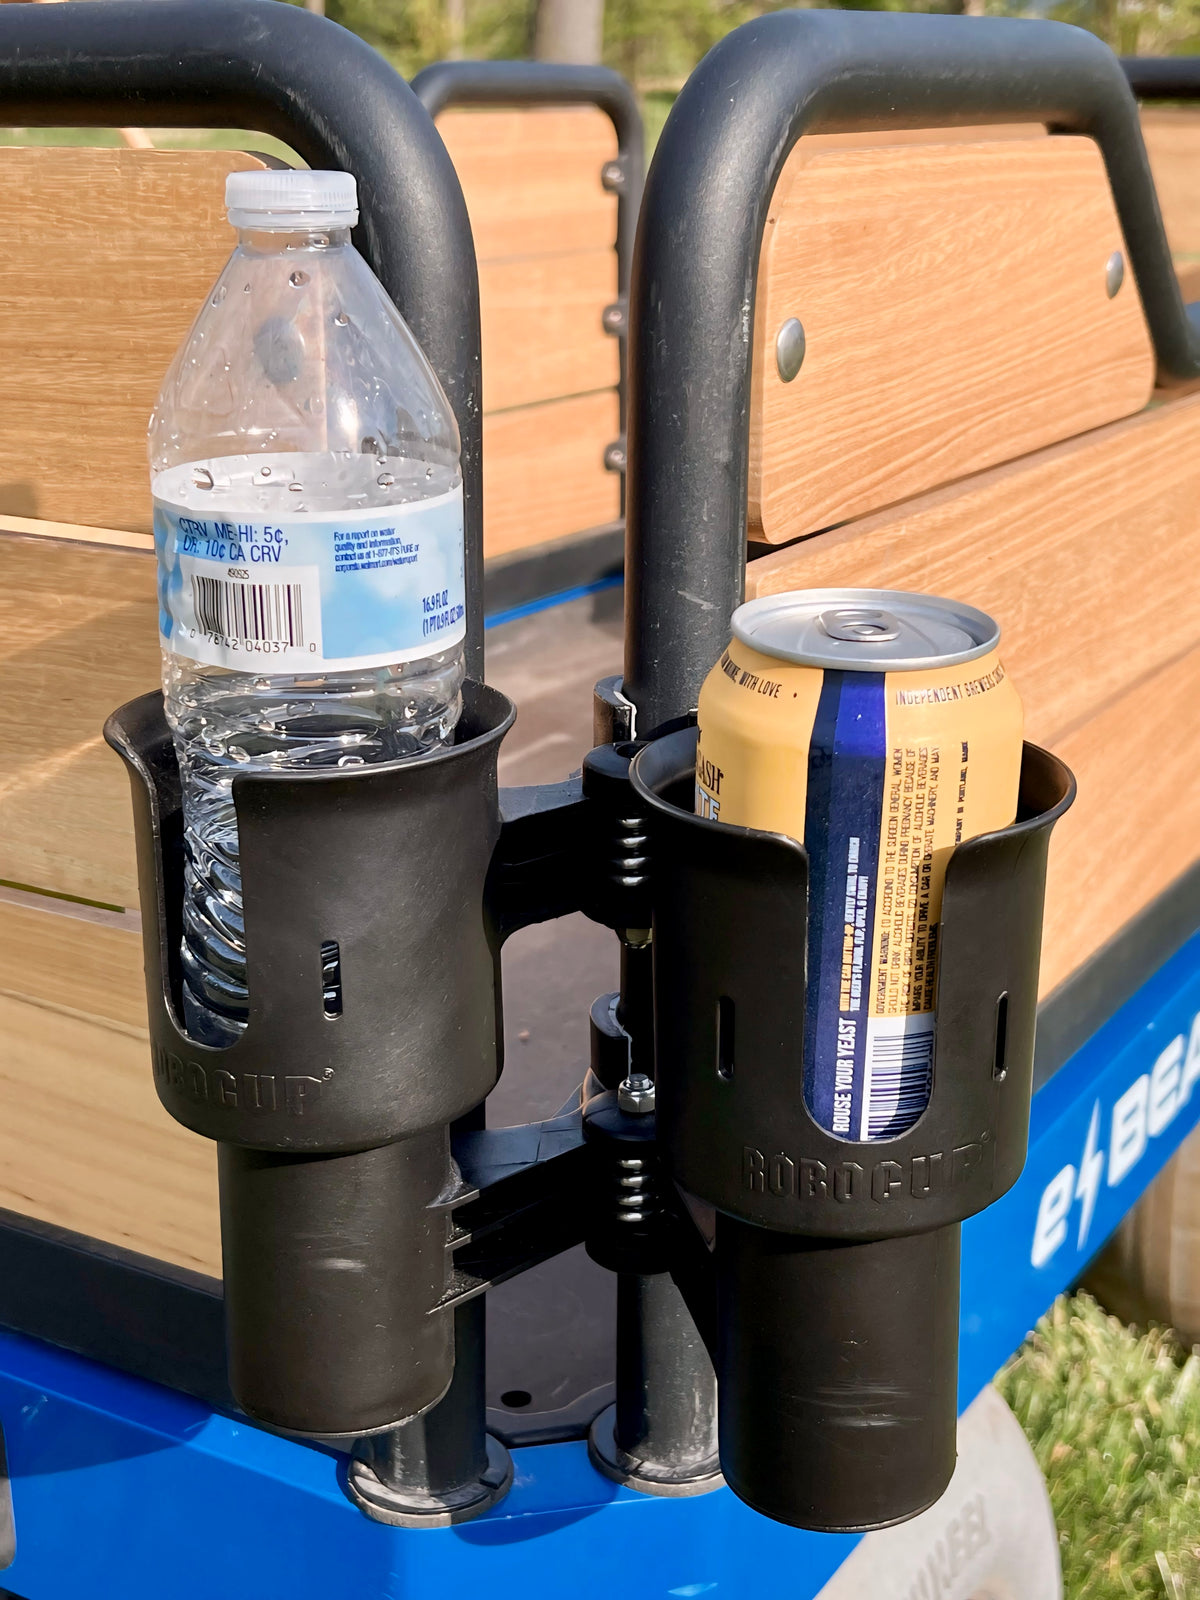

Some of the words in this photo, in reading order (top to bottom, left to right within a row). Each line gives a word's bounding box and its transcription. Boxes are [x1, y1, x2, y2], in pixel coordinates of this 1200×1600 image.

[230, 543, 246, 561] CA
[251, 545, 281, 562] CRV
[357, 541, 368, 549] and
[436, 593, 441, 609] FL
[442, 589, 448, 606] OZ
[246, 641, 288, 652] 04037
[310, 643, 316, 652] 0
[758, 679, 782, 698] LOVE
[896, 685, 963, 705] INDEPENDENT
[892, 749, 902, 776] WOMEN
[906, 749, 915, 757] OF
[931, 747, 939, 763] MAY
[904, 761, 915, 792] BECAUSE
[917, 747, 928, 789] BEVERAGES
[930, 767, 939, 781] AND
[901, 796, 912, 837] PREGNANCY
[914, 794, 925, 830] ALCOHOLIC
[886, 851, 896, 863] THE
[898, 841, 909, 864] DURING
[885, 866, 895, 875] TO
[922, 864, 932, 872] OR
[921, 875, 930, 890] CAR
[918, 902, 928, 921] DRIVE
[893, 911, 904, 946] ALCOHOLIC
[917, 924, 927, 932] TO
[891, 951, 901, 969] DRINK
[891, 973, 900, 985] NOT
[914, 965, 924, 981] YOUR
[876, 968, 888, 1014] GOVERNMENT
[837, 1017, 856, 1056] YEAST
[835, 1059, 854, 1091] YOUR
[833, 1093, 852, 1132] ROUSE
